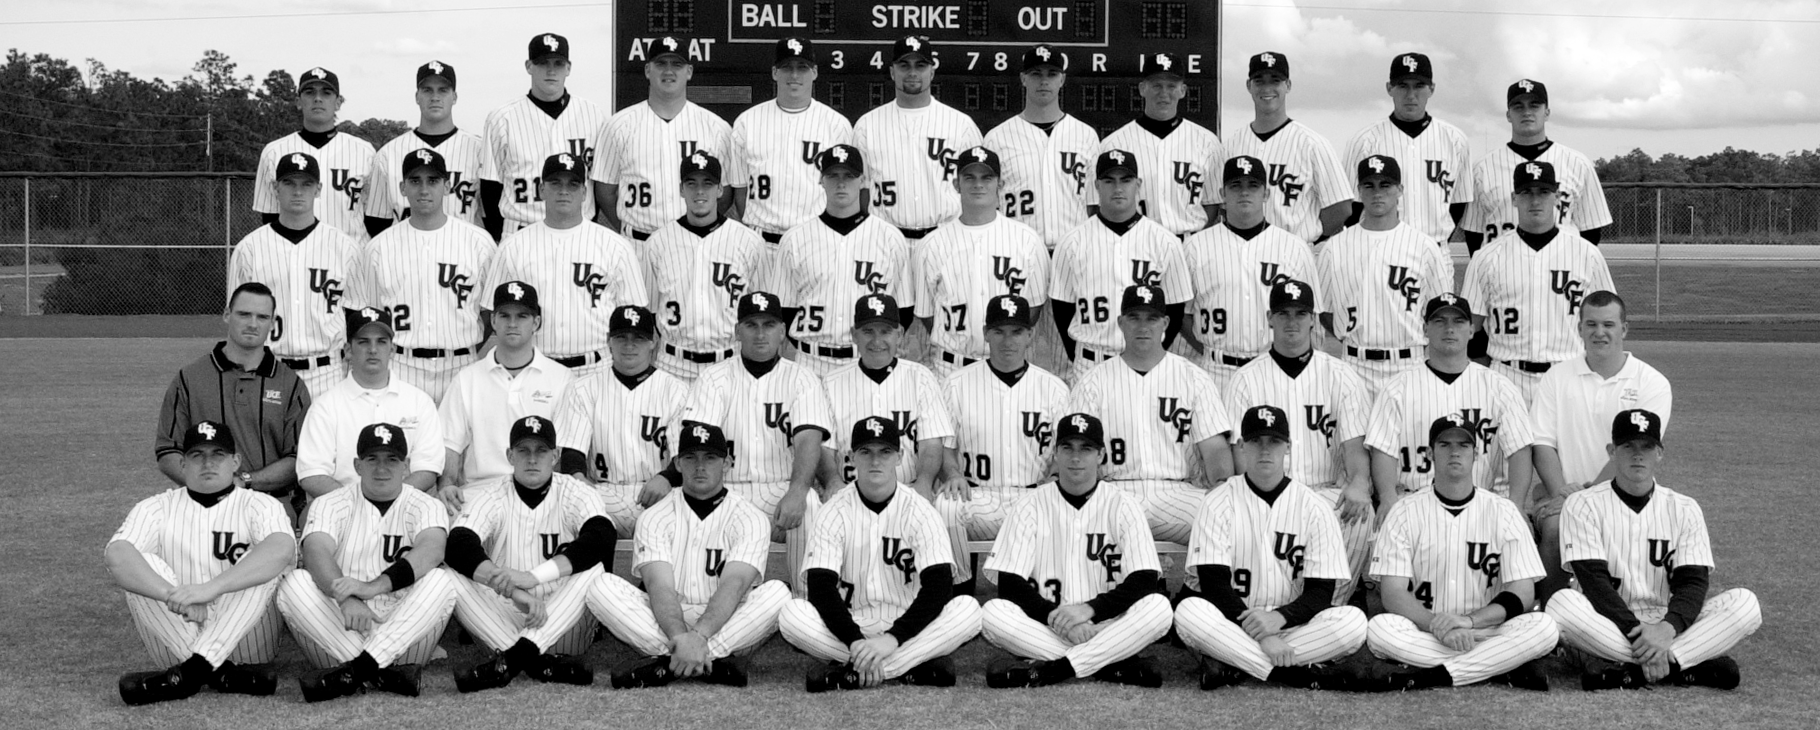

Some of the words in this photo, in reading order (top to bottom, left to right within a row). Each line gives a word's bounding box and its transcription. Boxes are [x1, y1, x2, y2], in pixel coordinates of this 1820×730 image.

[742, 4, 807, 27] BALL
[871, 5, 960, 28] STRIKE
[1017, 7, 1068, 30] OUT
[831, 51, 844, 69] 3
[869, 51, 883, 69] 4
[966, 52, 980, 71] 7
[994, 52, 1008, 71] 8
[1092, 53, 1107, 72] R
[1188, 55, 1201, 73] E
[514, 177, 543, 203] 21
[625, 182, 651, 208] 36
[1005, 190, 1034, 217] 22
[385, 304, 411, 331] 2
[1078, 296, 1109, 324] 26
[1493, 308, 1519, 334] 12
[964, 452, 990, 480] 10
[1401, 447, 1431, 473] 13
